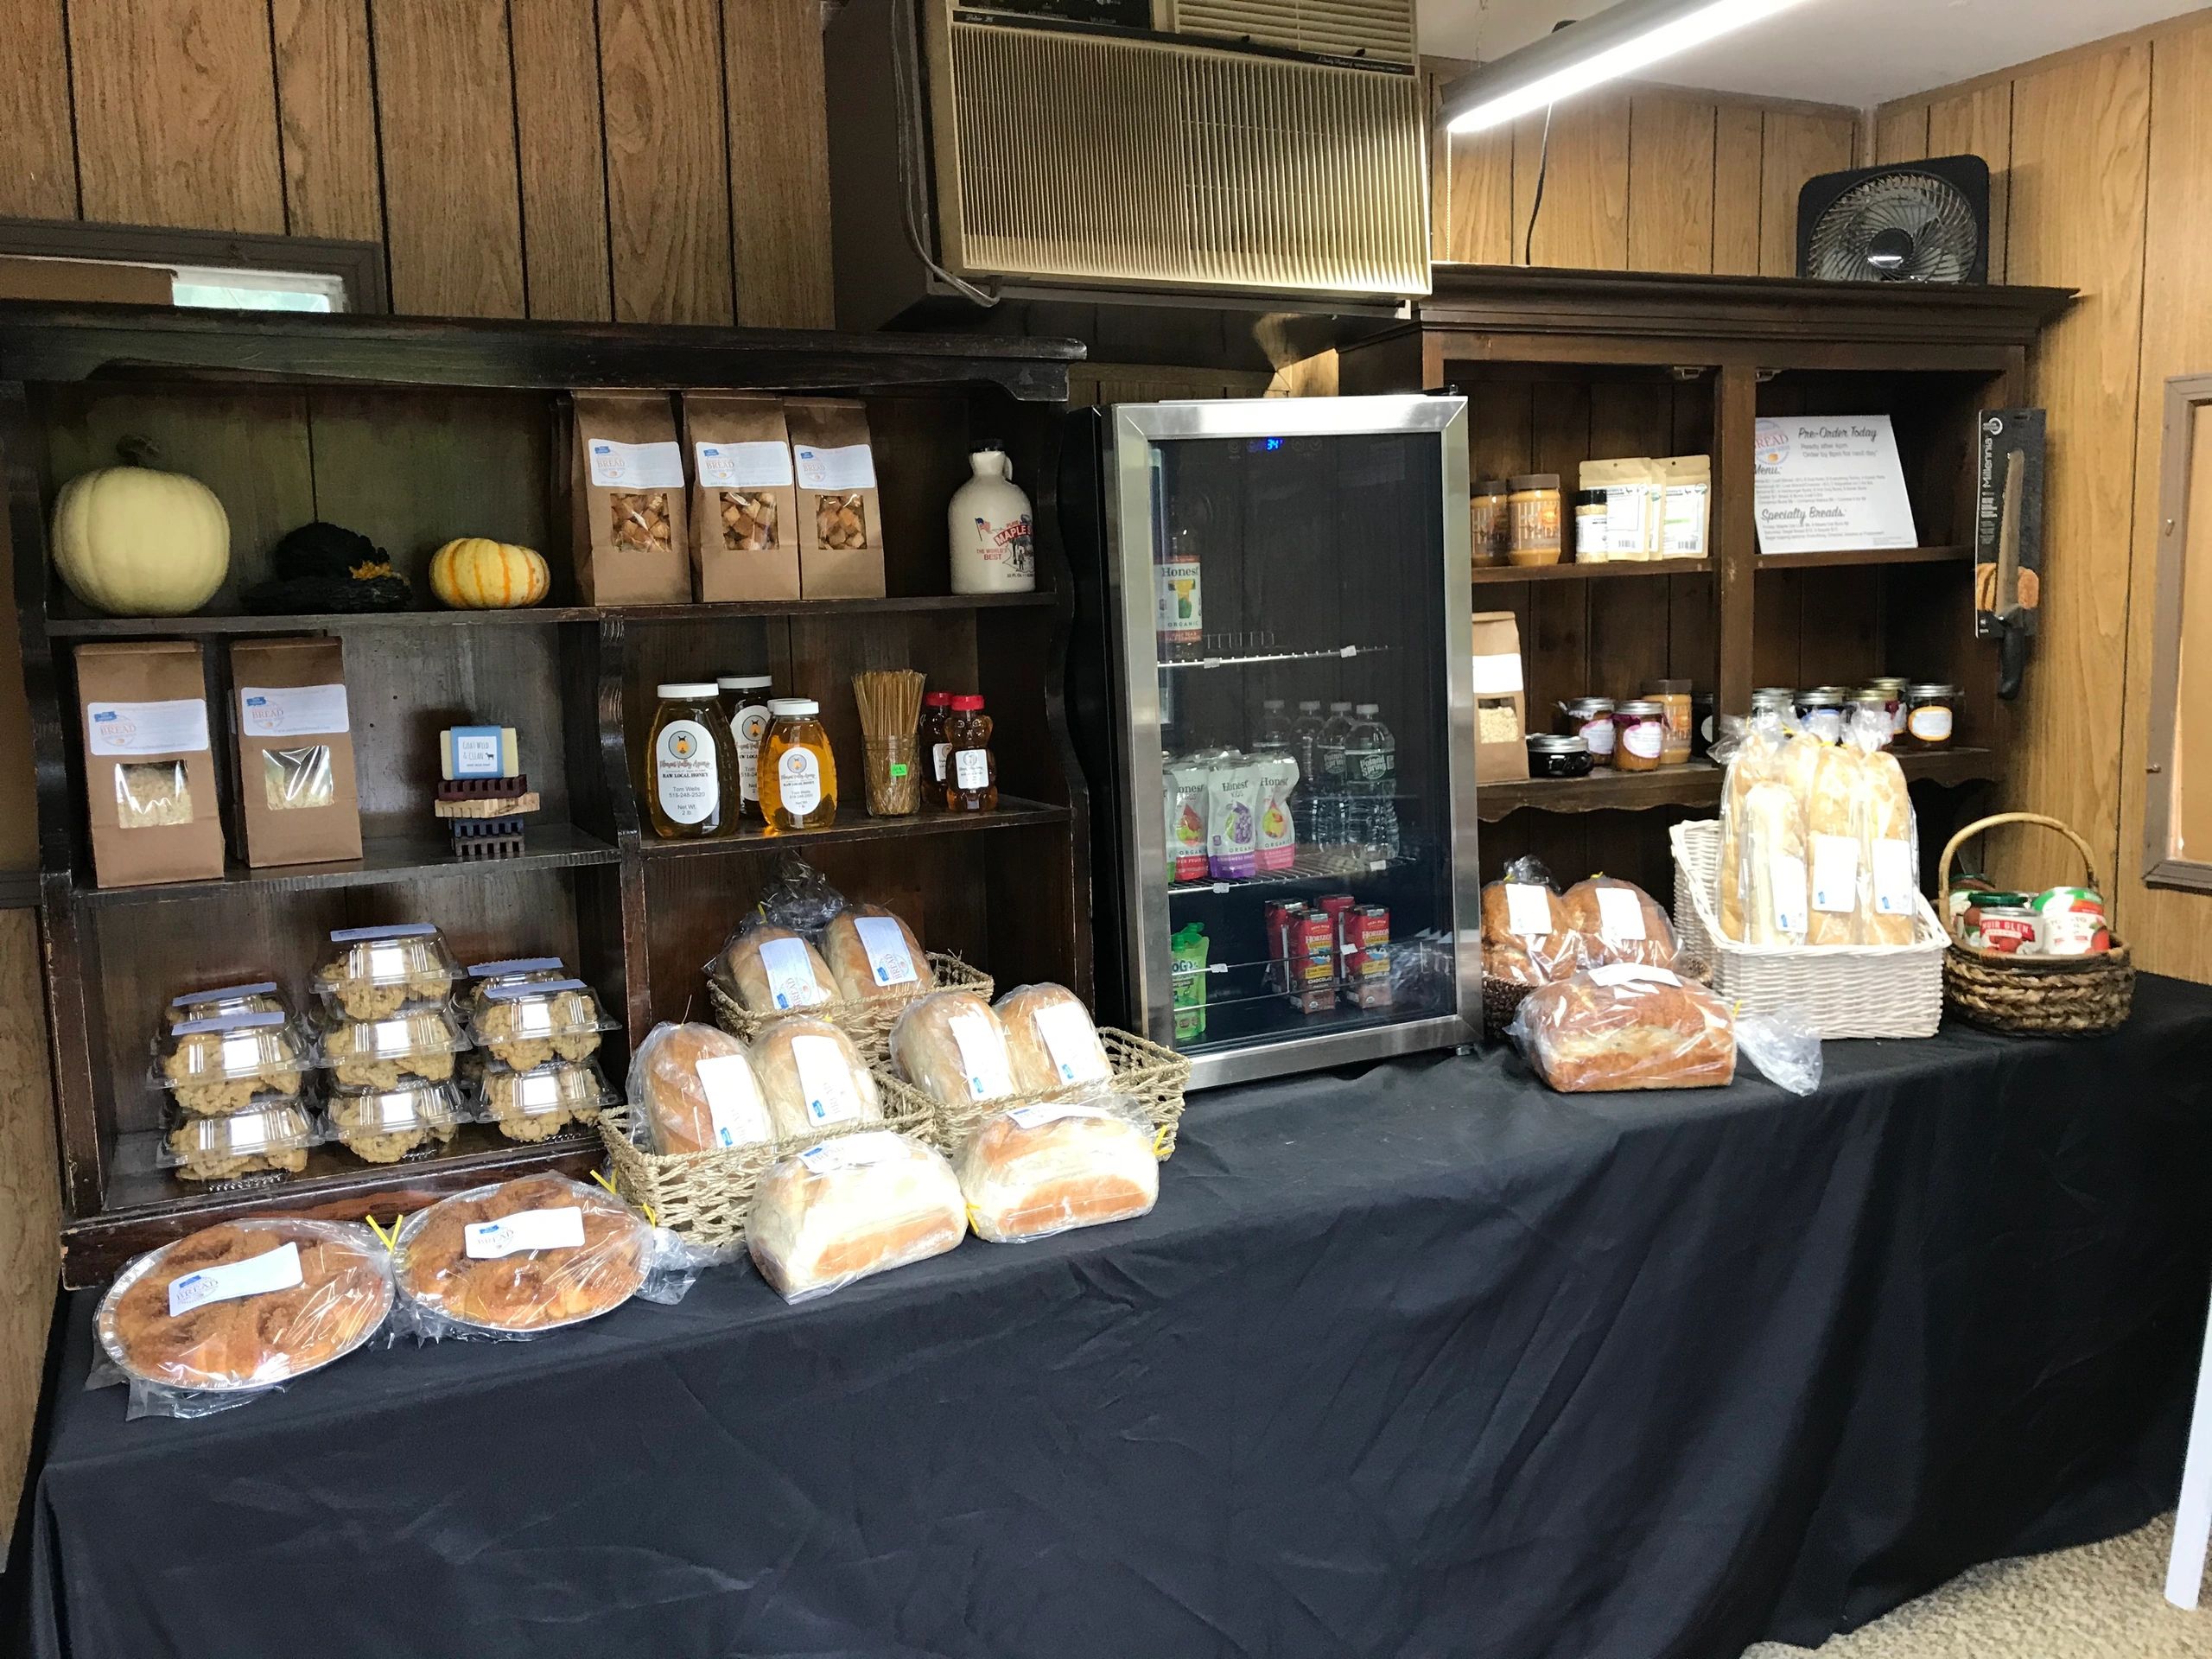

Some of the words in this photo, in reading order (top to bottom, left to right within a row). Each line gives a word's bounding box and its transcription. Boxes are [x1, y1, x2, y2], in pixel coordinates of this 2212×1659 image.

[1852, 426, 1878, 442] Today
[1755, 435, 1789, 449] READ
[597, 459, 625, 468] BREAD
[706, 461, 734, 470] BREAD
[1983, 437, 1993, 488] Millennia
[1761, 507, 1806, 524] Specialty
[995, 524, 1027, 545] MAPLE
[1161, 566, 1198, 577] Honest
[252, 709, 284, 720] BREAD
[100, 725, 137, 735] BREAD
[1360, 754, 1385, 766] Poland
[1361, 762, 1387, 777] Spring
[1223, 780, 1249, 791] Honest
[1260, 777, 1289, 786] Honest
[1179, 784, 1205, 793] onest
[1982, 919, 2001, 930] MUIR
[2004, 921, 2030, 934] GLEN
[886, 954, 902, 980] BREAD
